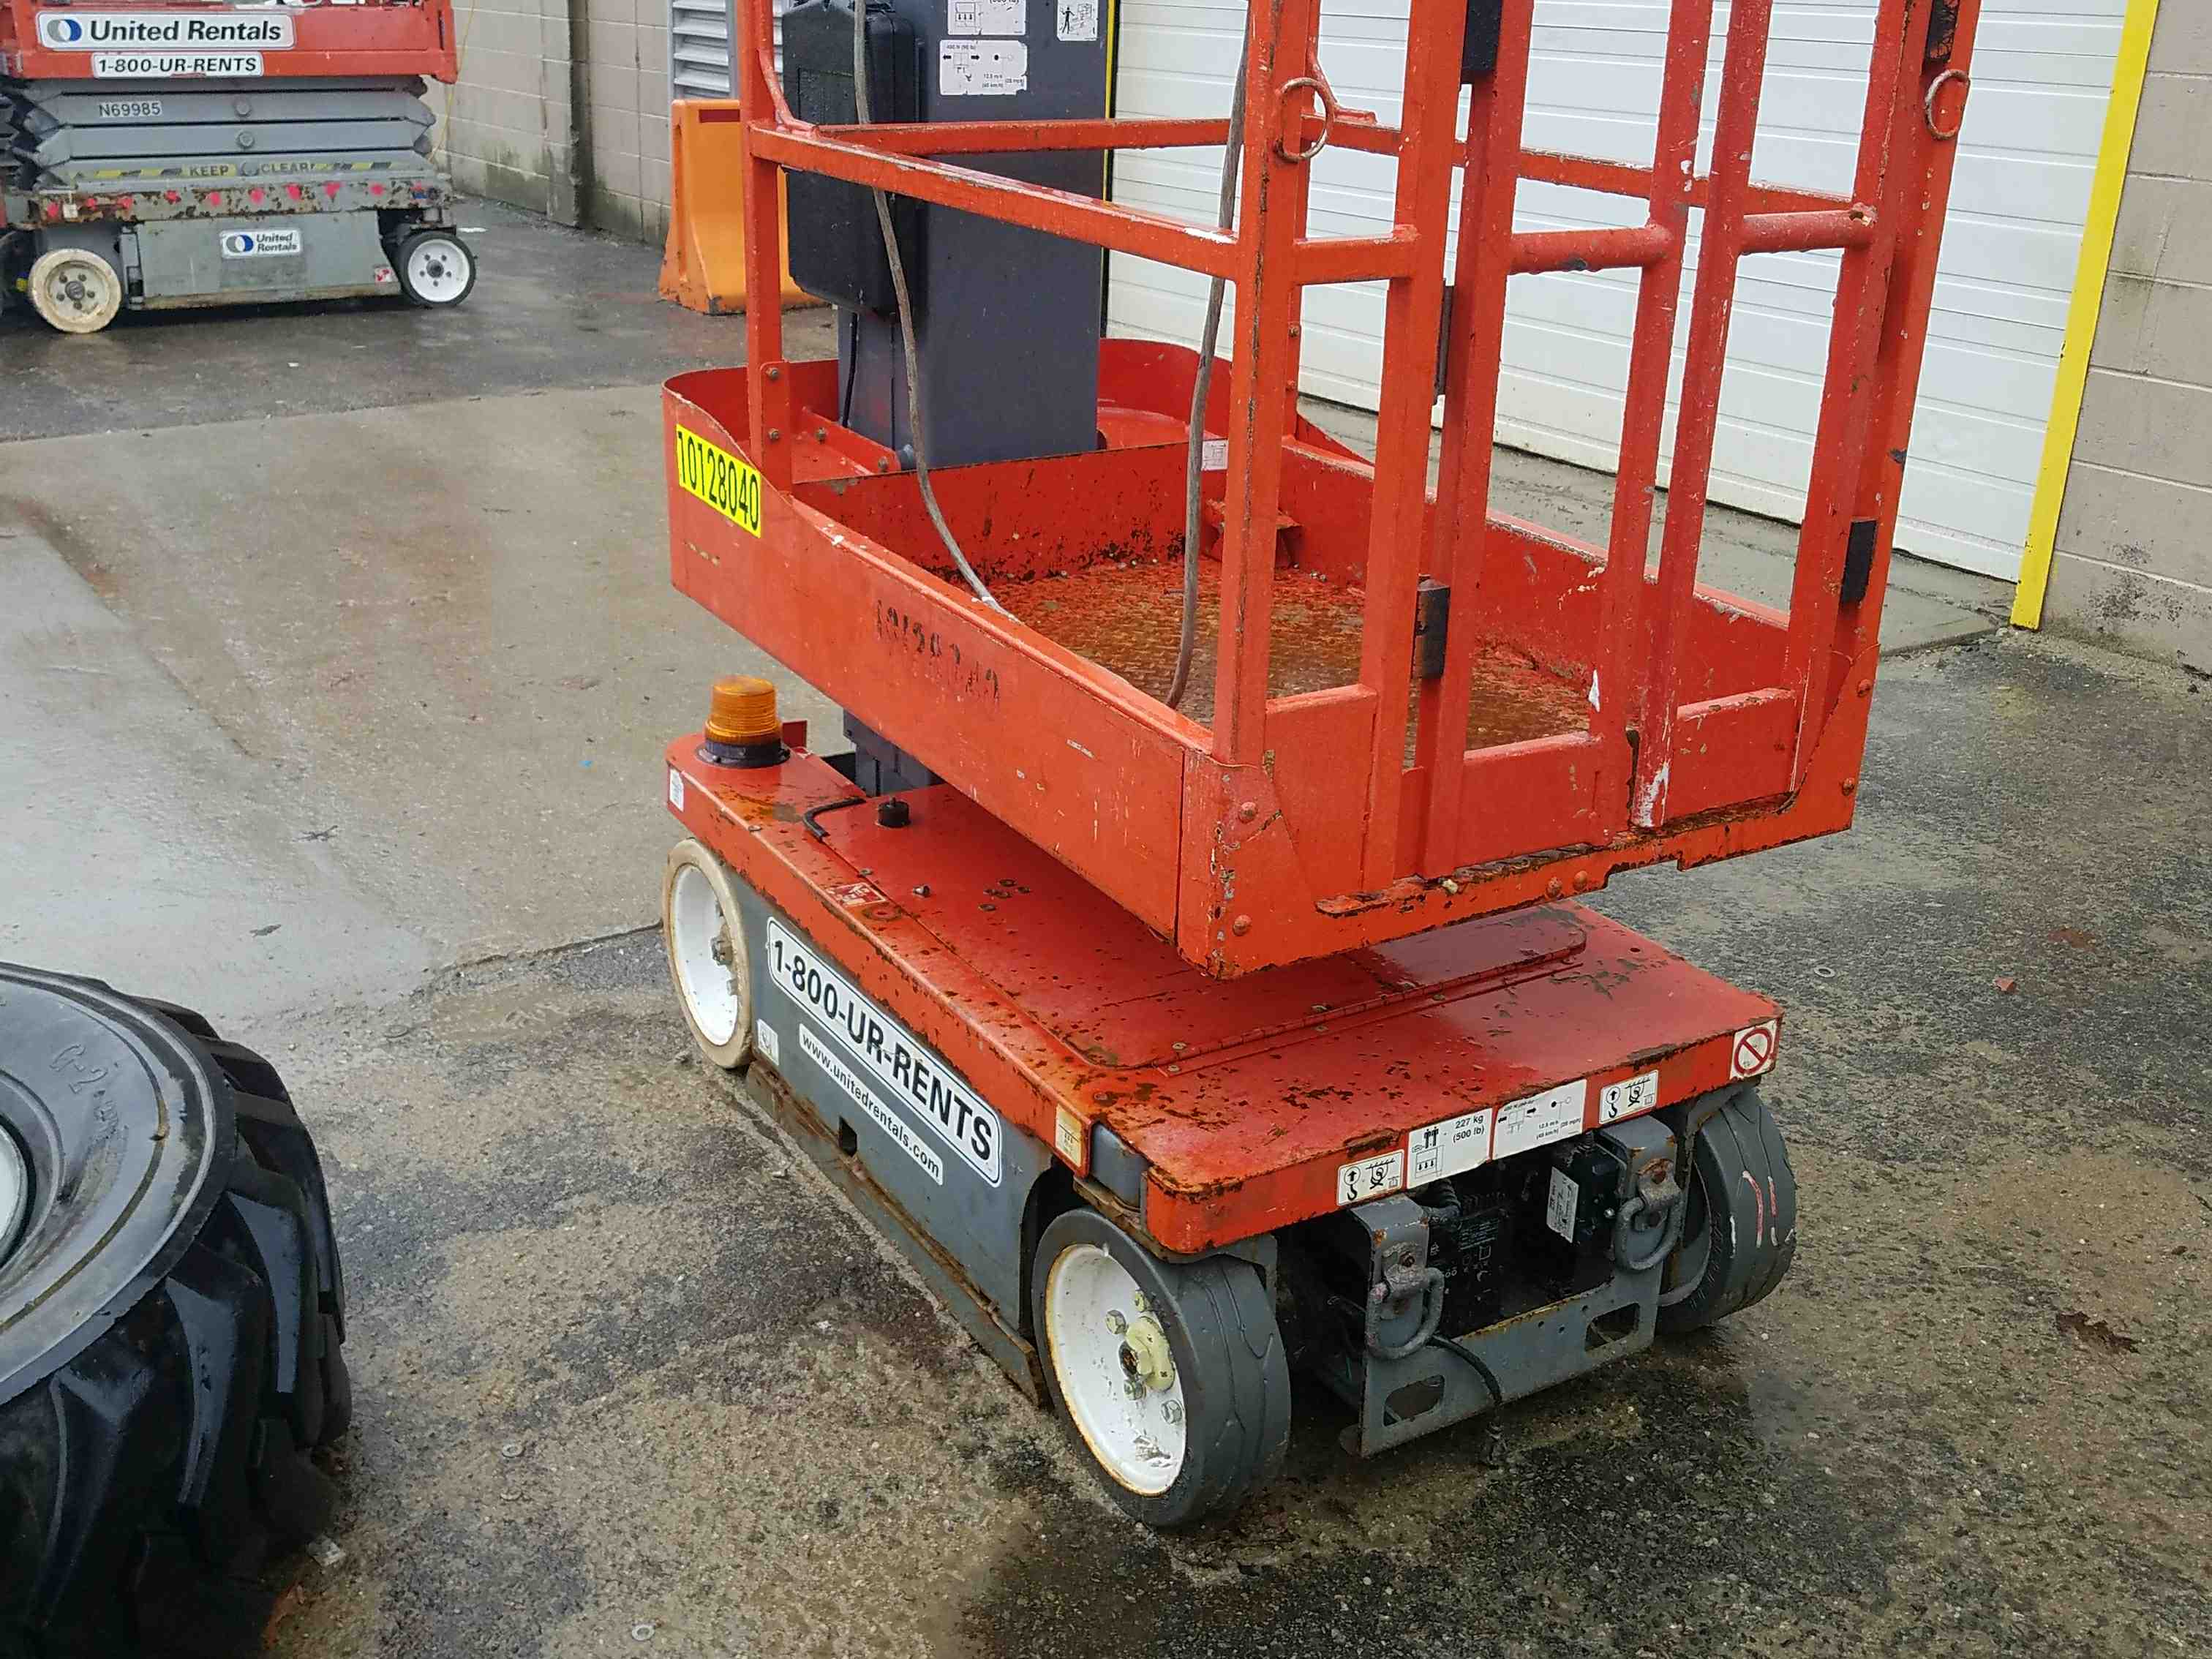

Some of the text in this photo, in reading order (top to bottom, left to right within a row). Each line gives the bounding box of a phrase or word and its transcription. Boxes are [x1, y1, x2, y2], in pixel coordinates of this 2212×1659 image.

[90, 20, 282, 40] United Rentals
[99, 57, 256, 72] 1-800-UR-RENTS
[99, 102, 161, 117] N69985
[189, 165, 229, 176] KEEP
[256, 233, 298, 252] United Rentals
[677, 431, 759, 531] 10128040
[774, 940, 991, 1162] 1-800-UR-RENTS
[803, 1033, 939, 1178] www.unitedrentals.com
[1455, 1115, 1483, 1129] 227 kg
[1452, 1125, 1485, 1143] (500 lb)
